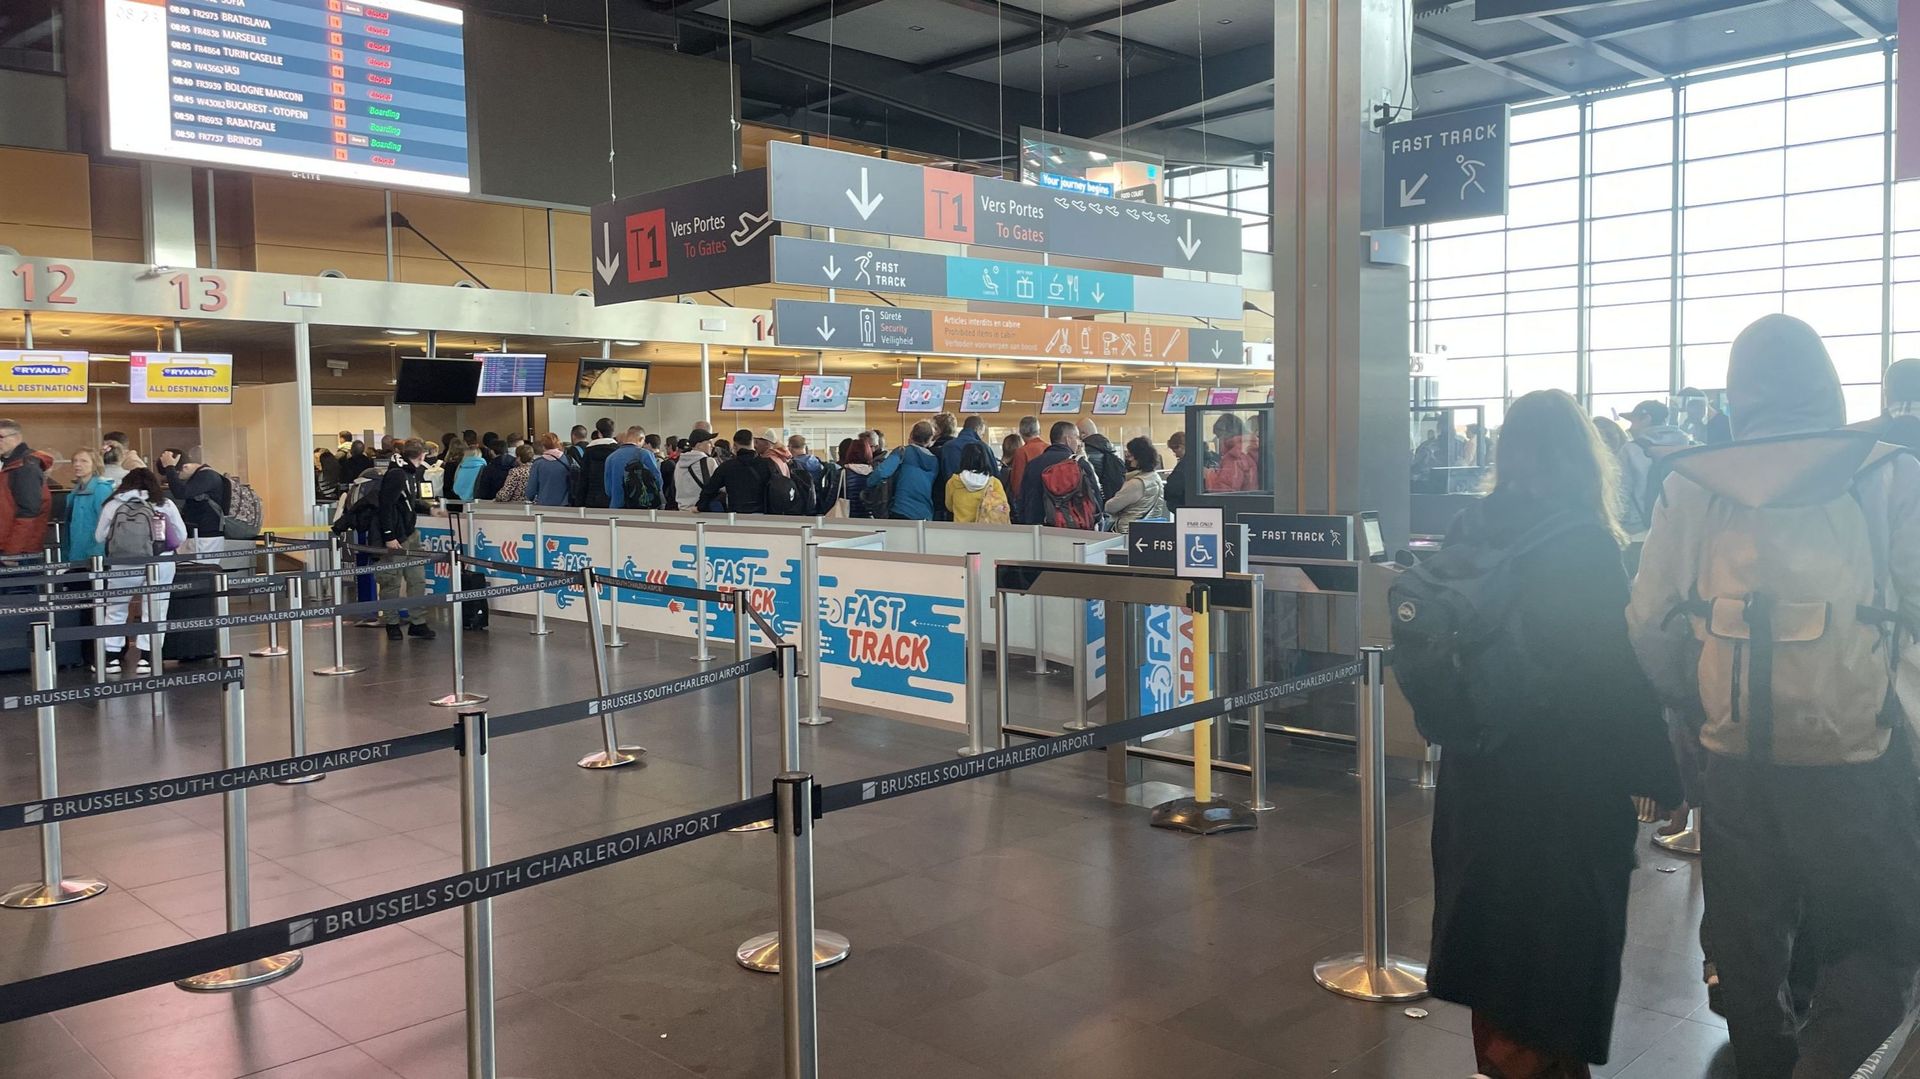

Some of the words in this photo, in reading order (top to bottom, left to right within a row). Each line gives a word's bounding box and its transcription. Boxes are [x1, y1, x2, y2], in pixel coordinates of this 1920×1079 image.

[221, 12, 272, 30] BRATISLAVA
[222, 30, 268, 46] MARSEILLE
[222, 47, 249, 59] TURIN
[250, 52, 283, 66] CASELLE
[224, 64, 240, 75] IASI
[224, 82, 264, 96] BOLOGNE
[264, 88, 303, 102] MARCONI
[226, 100, 268, 113] BUCAREST
[273, 107, 308, 119] OTOPENI
[369, 107, 400, 120] Boarding
[226, 117, 276, 132] RABAT/SALE
[370, 123, 400, 136] Boarding
[227, 135, 262, 146] BRINDISI
[371, 139, 402, 152] Boarding
[1392, 134, 1432, 154] FAST
[1440, 124, 1496, 146] TRACK
[1043, 174, 1059, 186] Your
[1060, 177, 1086, 194] journey
[1088, 181, 1109, 196] begins
[931, 189, 968, 232] T1
[980, 194, 1006, 214] Vers
[1009, 198, 1044, 219] Portes
[671, 218, 693, 238] Vers
[694, 214, 726, 234] Portes
[996, 222, 1010, 238] To
[1012, 224, 1044, 243] Gates
[630, 224, 662, 271] T1
[684, 241, 696, 258] To
[698, 239, 728, 256] Gates
[876, 262, 899, 273] FAST
[12, 263, 78, 304] 12
[876, 276, 906, 287] TRACK
[168, 274, 228, 312] 13
[880, 310, 902, 320] Sûreté
[944, 315, 968, 326] Articles
[968, 318, 992, 327] interdits
[1002, 320, 1020, 328] cabine
[880, 324, 908, 334] Security
[881, 335, 914, 346] Veiligheid
[22, 366, 69, 374] RYANAIR
[18, 384, 84, 392] DESTINATIONS
[1154, 540, 1175, 550] FAS
[1262, 530, 1286, 540] FAST
[1291, 531, 1324, 542] TRACK
[328, 569, 354, 577] BRUSSELS
[356, 567, 376, 575] SOUTH
[377, 562, 408, 572] CHARLEROI
[409, 558, 432, 567] AIRPORT
[715, 560, 757, 584] FAST
[50, 592, 86, 601] BRUSSELS
[117, 586, 159, 596] CHARLEROI
[160, 583, 192, 592] AIRPORT
[456, 589, 486, 600] BRUSSELS
[488, 586, 511, 596] SOUTH
[512, 581, 548, 594] CHARLEROI
[548, 576, 574, 588] AIRPORT
[718, 586, 774, 613] TCK
[0, 606, 16, 615] UTH
[18, 604, 72, 614] CHARLEROI
[170, 617, 214, 630] BRUSSELS
[216, 614, 248, 627] SOUTH
[250, 610, 298, 624] CHARLEROI
[300, 606, 336, 618] AIRPORT
[843, 596, 904, 630] FAST
[1150, 603, 1172, 662] FA
[849, 629, 928, 669] TRACK
[24, 684, 90, 706] BRUSSELS
[94, 678, 142, 698] SOUTH
[146, 671, 220, 691] CHARLEROI
[602, 692, 642, 711] BRUSSELS
[643, 685, 673, 701] SOUTH
[674, 672, 718, 693] CHARLEROI
[718, 662, 750, 680] AIRPORT
[1234, 690, 1268, 708] BRUSSELS
[1269, 683, 1294, 700] SOUTH
[1296, 671, 1333, 692] CHARLEROI
[1334, 663, 1362, 682] AIRPORT
[880, 769, 940, 795] BRUSSELS
[942, 760, 986, 782] SOUTH
[988, 745, 1050, 774] CHARLEROI
[1052, 733, 1095, 756] AIRPORT
[52, 788, 144, 817] BRUSSELS
[149, 778, 215, 800] SOUTH
[220, 760, 319, 788] CHARLEROI
[323, 744, 392, 773] AIRPORT
[326, 888, 437, 934] BRUSSELS
[444, 867, 521, 902] SOUTH
[526, 835, 640, 880] CHARLEROI
[644, 814, 722, 847] AIRPORT
